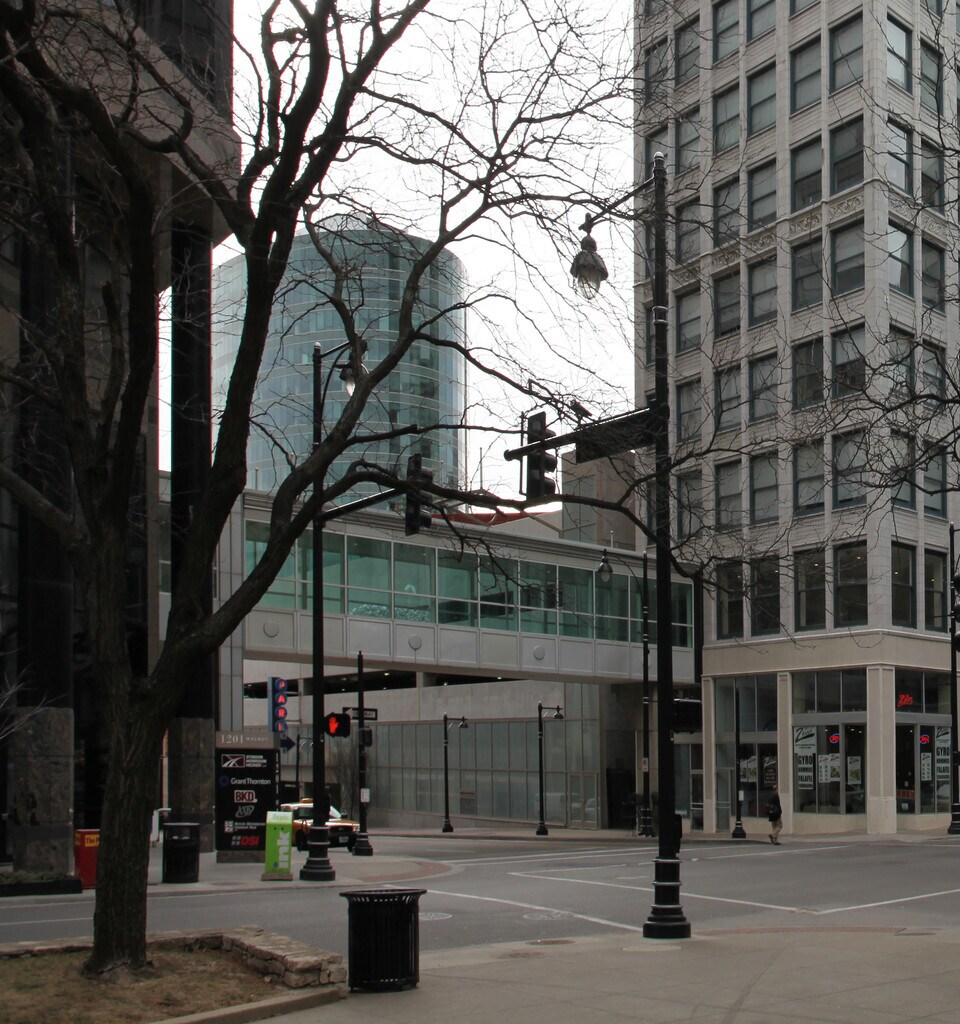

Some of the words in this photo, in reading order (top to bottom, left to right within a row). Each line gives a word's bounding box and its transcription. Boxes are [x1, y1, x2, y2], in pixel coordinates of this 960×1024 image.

[221, 734, 244, 744] 1201
[230, 777, 246, 785] Grant
[246, 777, 271, 785] Thornton
[235, 791, 254, 802] BKD
[241, 835, 260, 846] DSI
